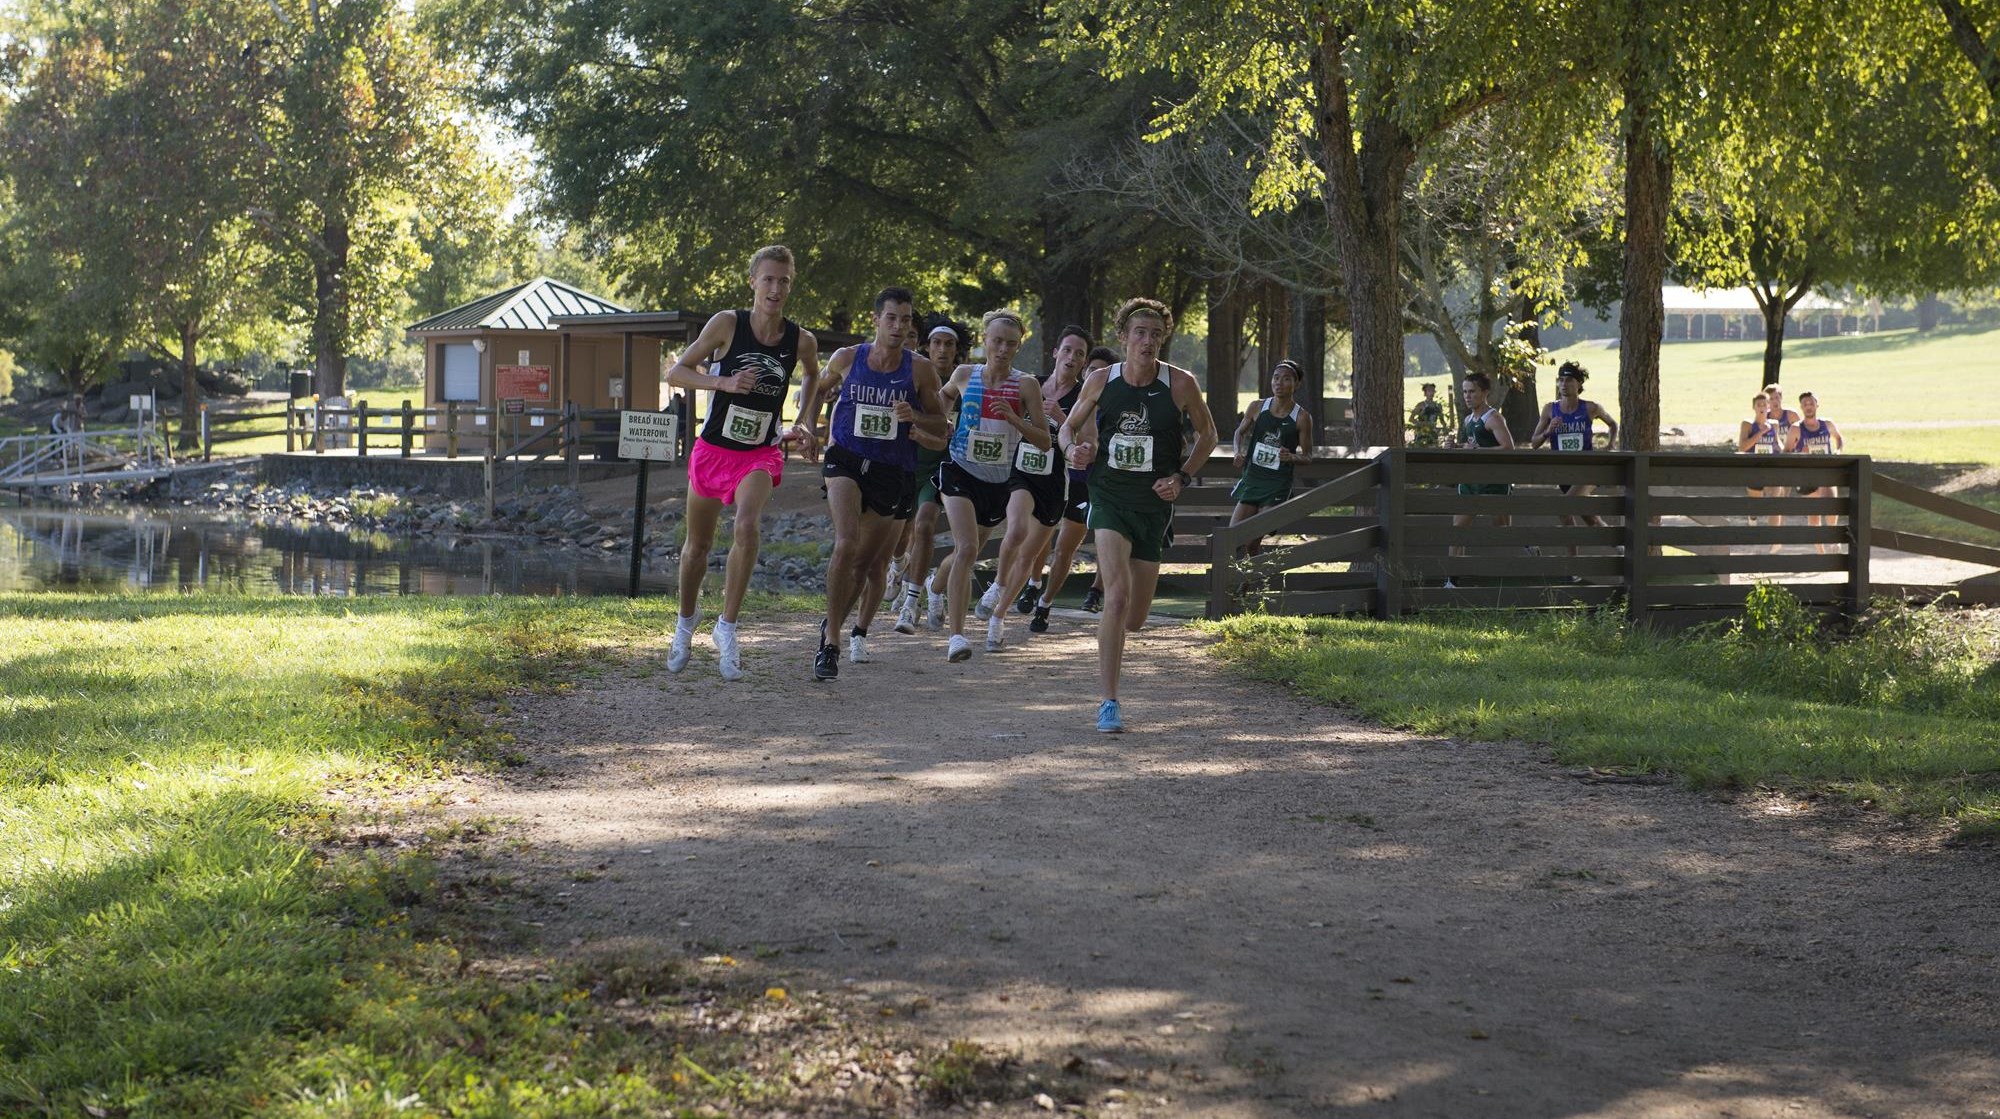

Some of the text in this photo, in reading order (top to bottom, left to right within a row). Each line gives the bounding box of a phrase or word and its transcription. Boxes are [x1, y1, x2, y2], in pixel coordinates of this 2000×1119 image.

[850, 384, 908, 405] FURMAN
[629, 415, 670, 426] BREAD KILLS
[730, 415, 762, 438] 551
[861, 414, 891, 432] 518
[629, 428, 668, 438] WATERFOWL
[973, 439, 1003, 458] 552
[1561, 438, 1580, 450] 528
[1022, 451, 1048, 469] 550
[1114, 443, 1145, 464] 510
[1257, 449, 1277, 464] 517
